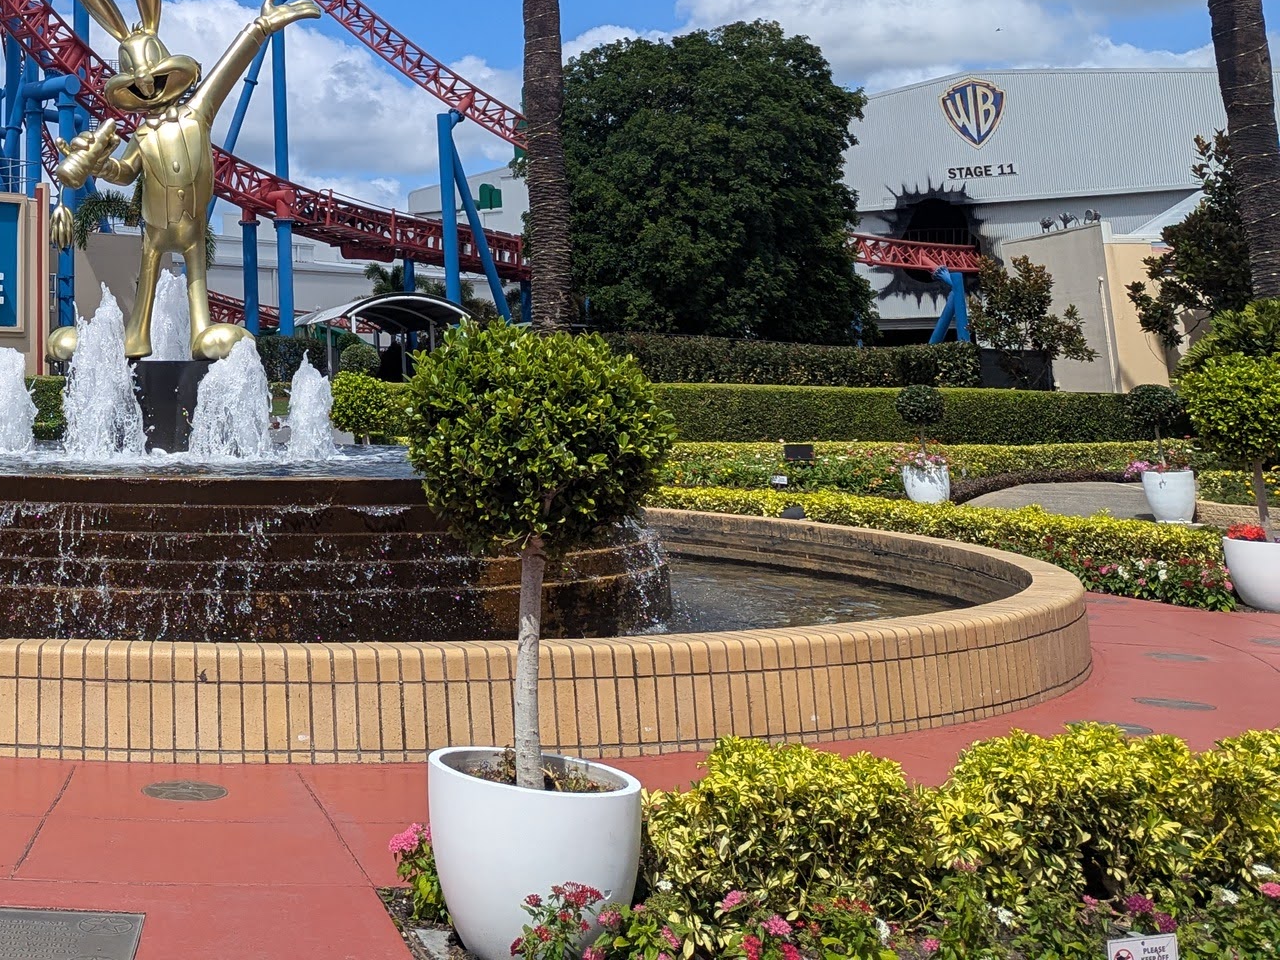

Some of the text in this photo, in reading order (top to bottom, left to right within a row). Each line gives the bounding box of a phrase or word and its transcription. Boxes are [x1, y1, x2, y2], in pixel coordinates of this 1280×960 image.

[946, 85, 996, 141] WB
[948, 163, 1017, 179] STAGE 11
[1143, 946, 1166, 954] PLEASE
